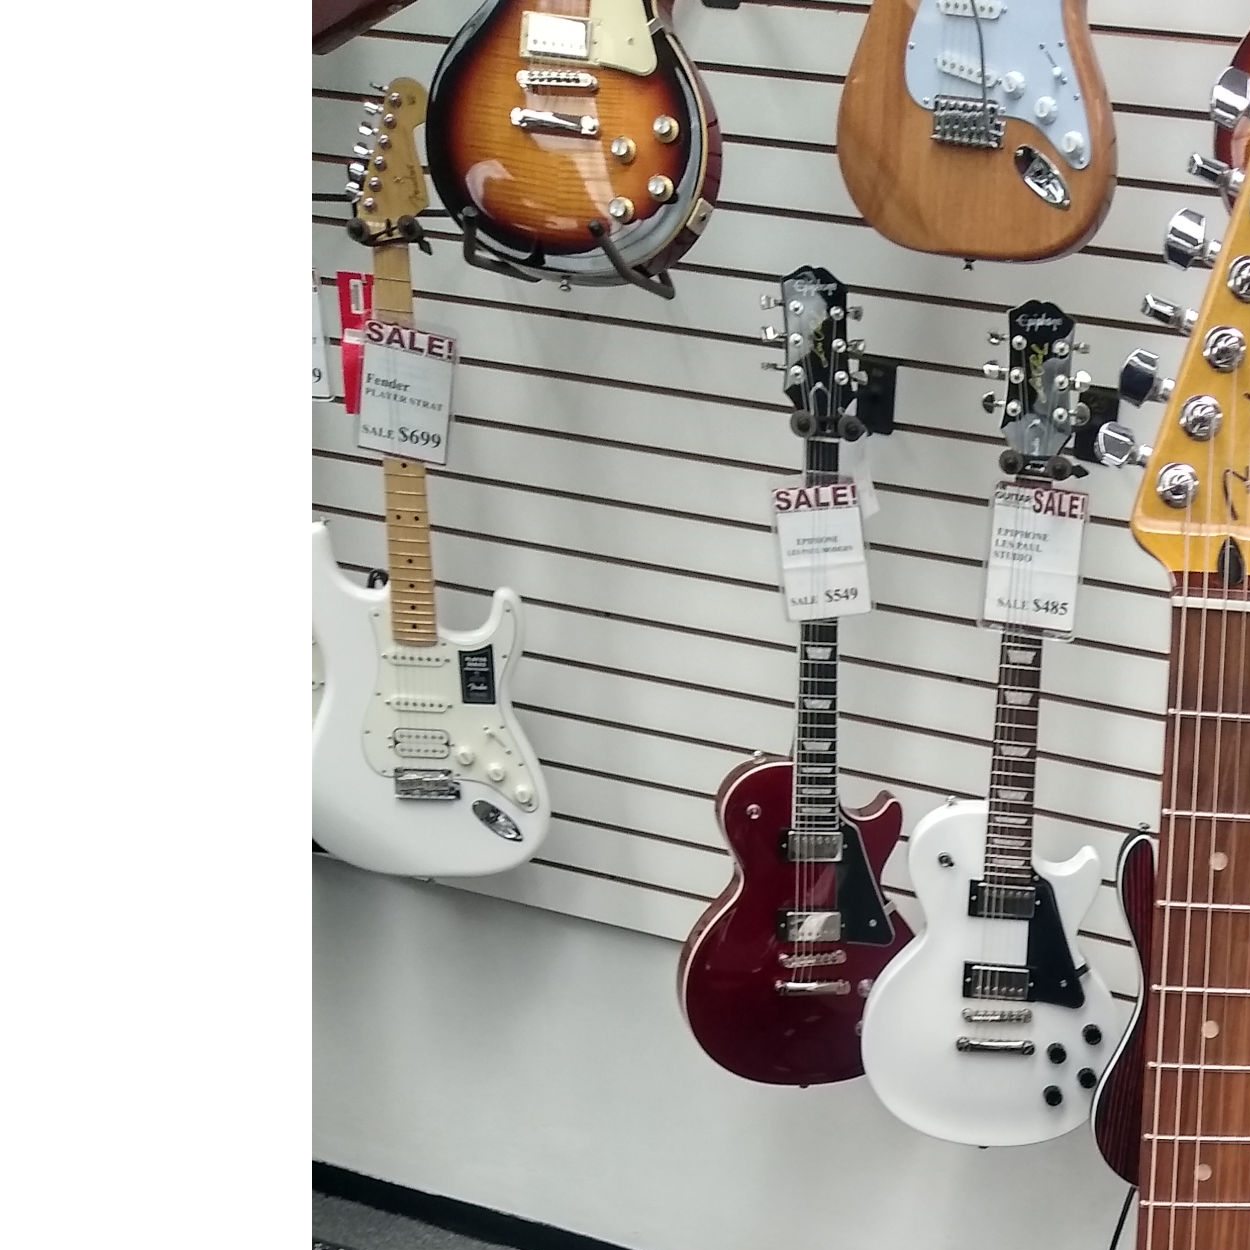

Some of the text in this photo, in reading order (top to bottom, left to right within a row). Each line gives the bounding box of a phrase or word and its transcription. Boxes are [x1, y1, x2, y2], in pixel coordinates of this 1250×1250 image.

[367, 321, 454, 360] SALE!
[367, 373, 410, 391] Fender
[361, 424, 441, 448] SALE $699
[775, 485, 857, 511] SALE!
[1032, 490, 1085, 520] SALE!
[825, 587, 858, 603] $549
[1032, 598, 1069, 615] $485
